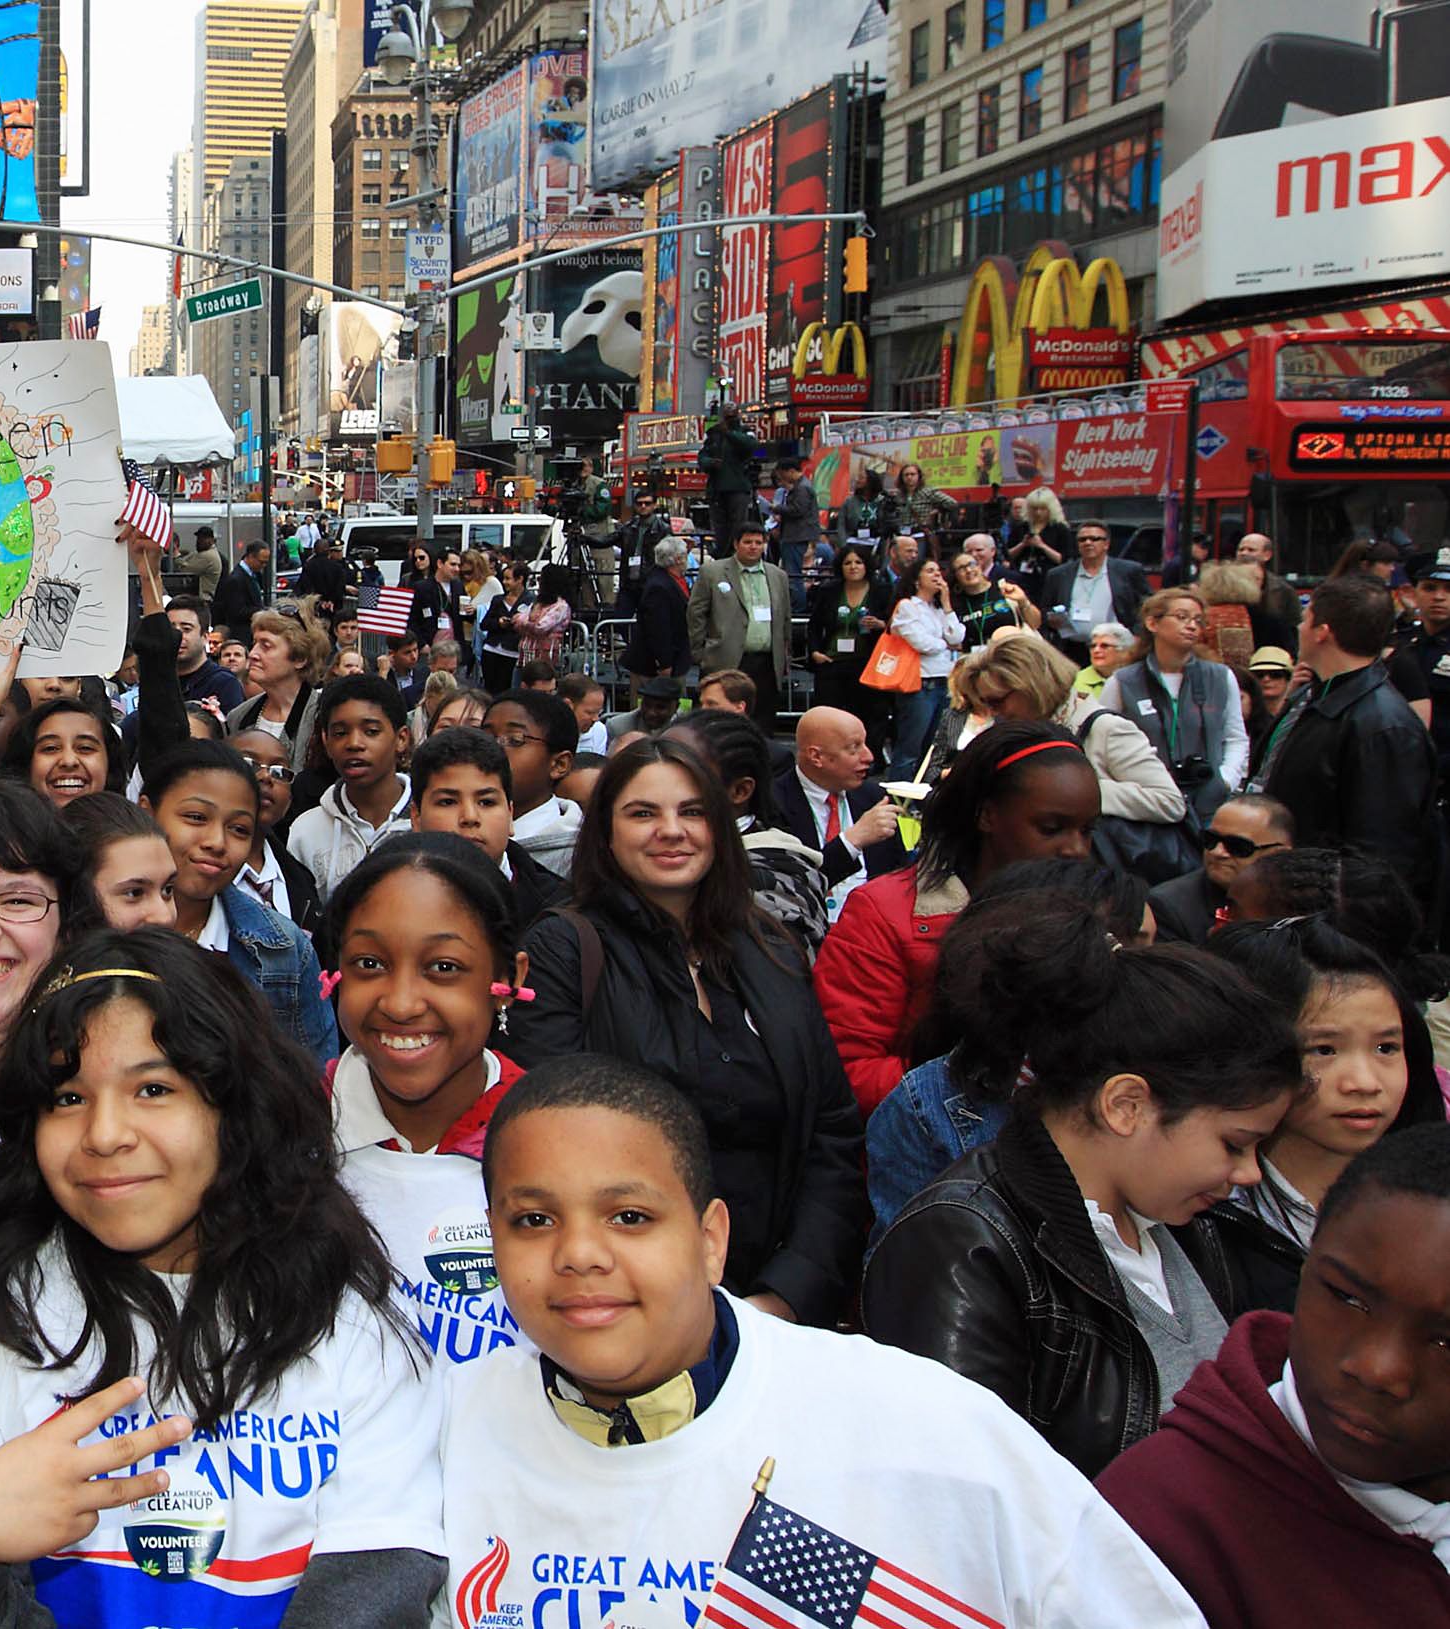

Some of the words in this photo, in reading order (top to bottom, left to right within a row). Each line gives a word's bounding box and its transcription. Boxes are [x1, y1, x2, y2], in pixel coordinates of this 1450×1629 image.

[601, 94, 635, 126] CARRIE
[638, 87, 656, 110] ON
[658, 79, 680, 101] MAY
[682, 71, 697, 92] 27
[1160, 179, 1204, 258] maxell
[415, 235, 444, 246] NYPD
[410, 256, 449, 267] SECURITY
[603, 252, 642, 269] belong
[693, 165, 713, 362] PALACE
[412, 266, 448, 277] CAMERA
[195, 290, 249, 316] Broadway
[1034, 338, 1130, 354] McDonald's
[794, 383, 867, 393] McDonald's
[534, 382, 640, 411] HANT
[1075, 421, 1110, 445] New
[1110, 416, 1148, 441] York
[1355, 433, 1415, 446] UPTOWN
[1061, 446, 1159, 477] Sightseeing
[443, 1224, 464, 1232] GREAT
[466, 1223, 490, 1231] AMERIC
[444, 1231, 492, 1243] CLEANU
[439, 1257, 494, 1272] VOLUNTEE
[400, 1279, 520, 1333] MERICAN
[99, 1413, 180, 1440] GRE
[192, 1409, 341, 1444] AMERICAN
[172, 1489, 214, 1498] AMERICAN
[147, 1497, 214, 1512] CLEANUP
[138, 1535, 209, 1549] VOLUNTEER
[532, 1553, 627, 1586] GREAT
[637, 1557, 715, 1592] AME
[500, 1603, 523, 1614] KEEP
[480, 1614, 524, 1627] AMERICA
